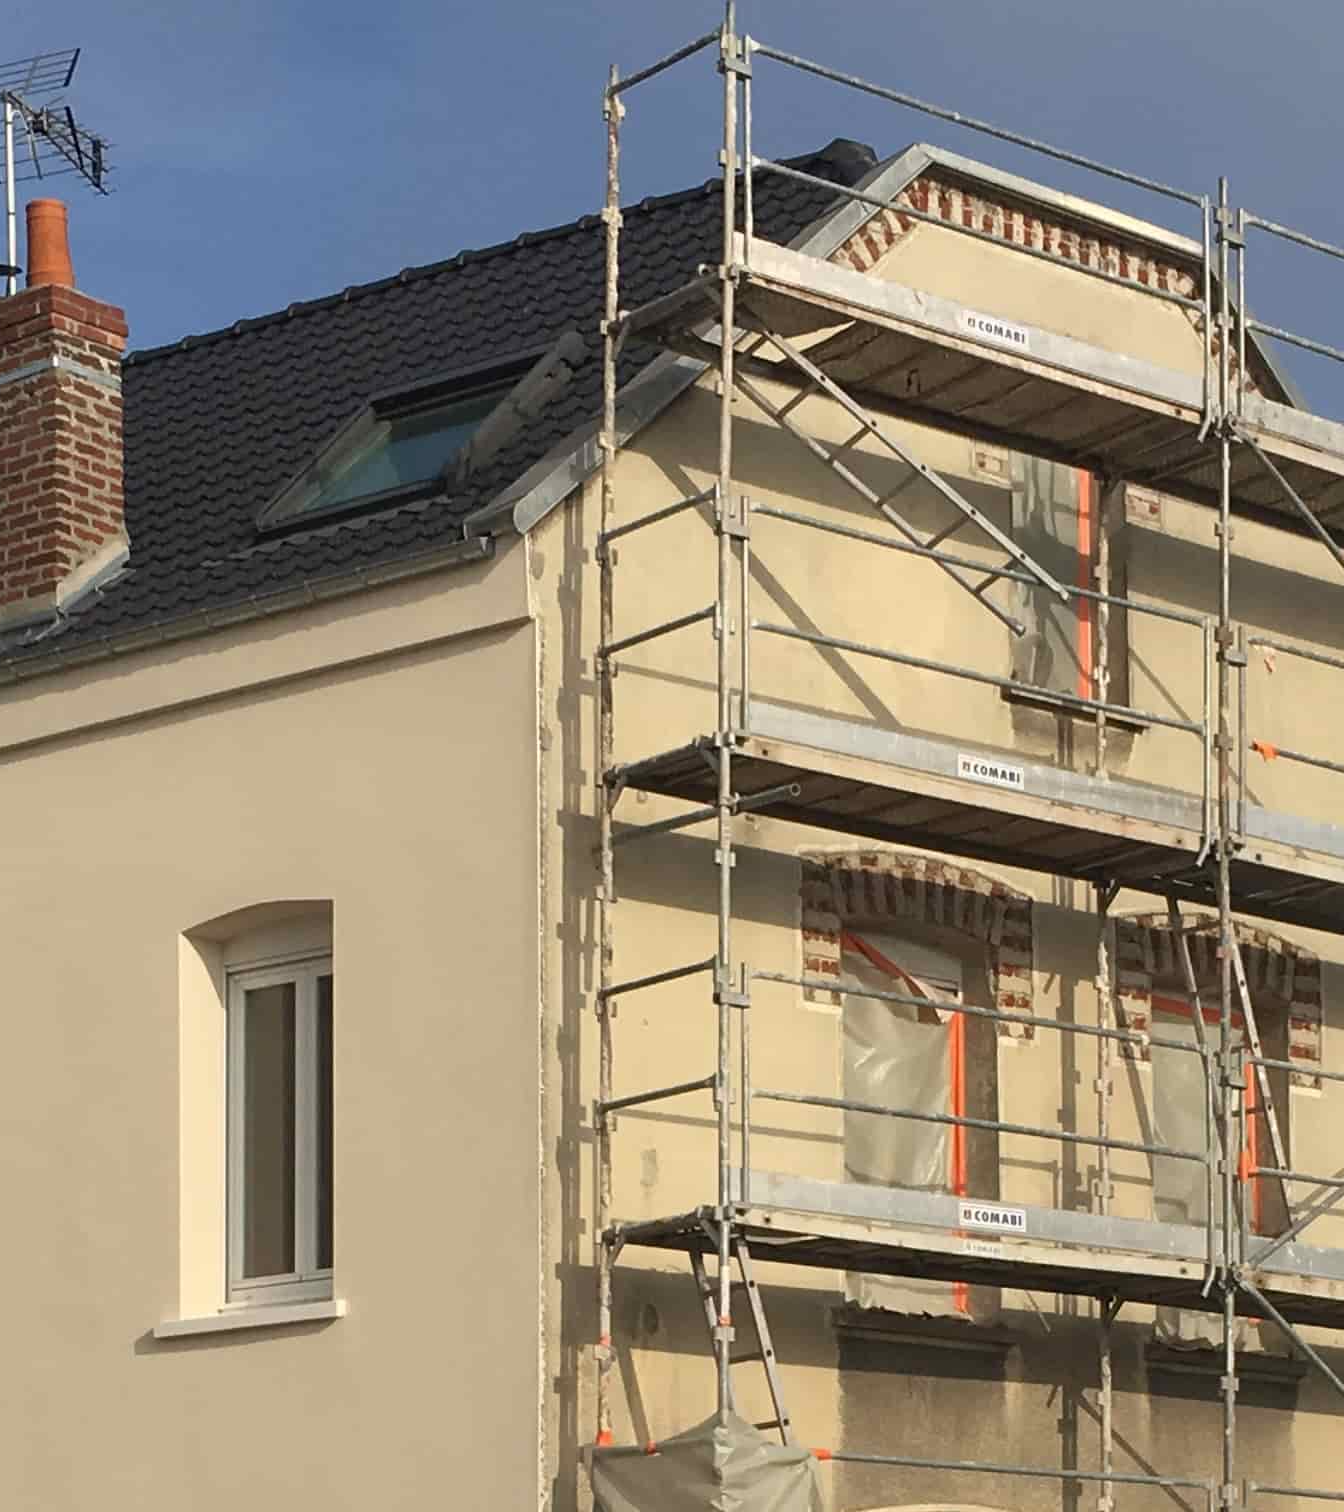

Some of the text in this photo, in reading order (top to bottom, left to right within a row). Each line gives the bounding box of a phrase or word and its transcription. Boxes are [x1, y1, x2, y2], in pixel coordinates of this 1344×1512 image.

[977, 319, 1025, 344] COMABI
[973, 763, 1021, 784] COMABI
[974, 1210, 1022, 1227] COMABI
